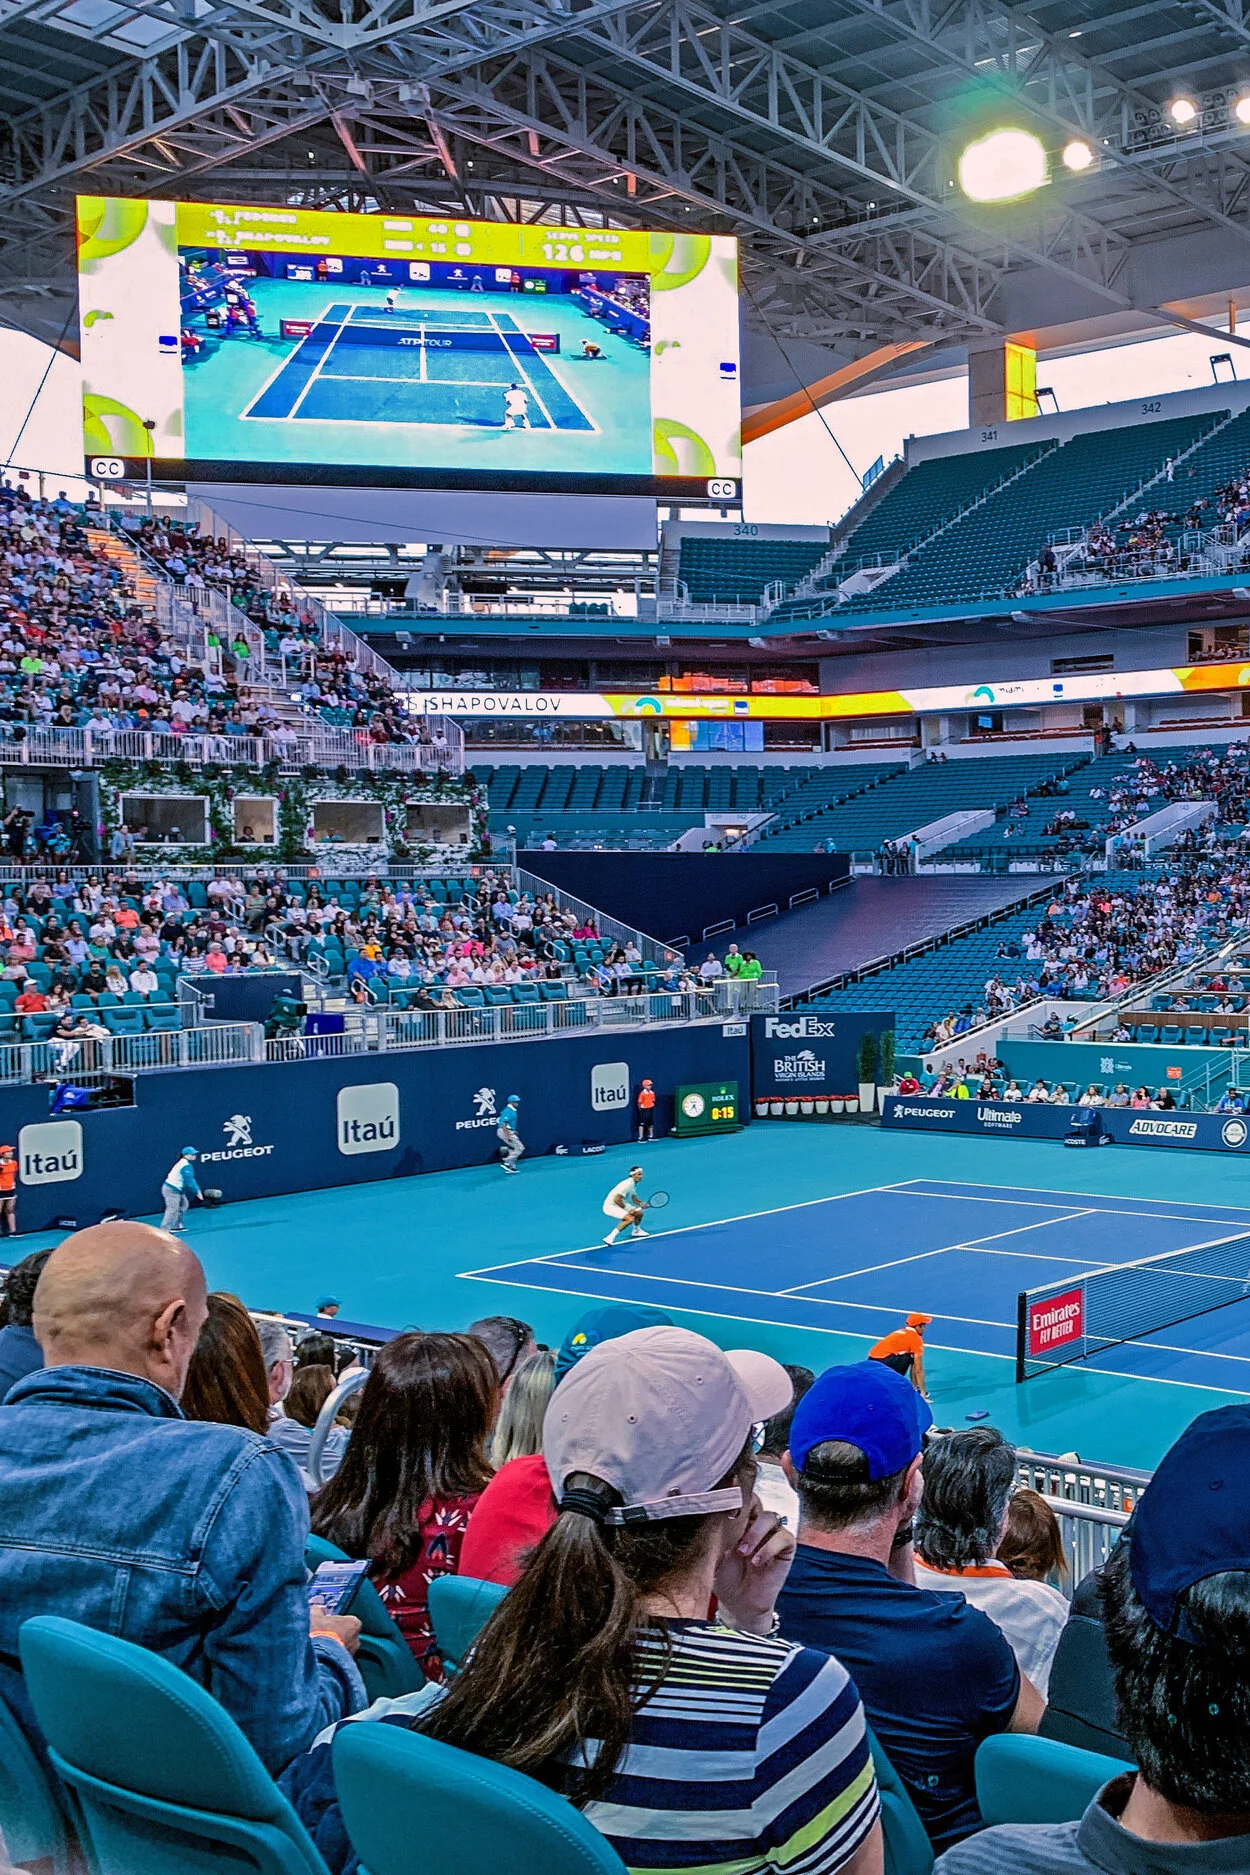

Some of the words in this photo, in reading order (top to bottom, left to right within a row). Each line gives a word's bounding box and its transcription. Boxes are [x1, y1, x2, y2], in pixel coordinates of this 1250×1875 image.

[541, 243, 585, 262] 126
[1141, 401, 1161, 415] 342
[981, 430, 998, 443] 341
[96, 461, 119, 475] CC
[711, 482, 732, 496] CC
[430, 697, 561, 711] SHAPOVALOV
[765, 1016, 835, 1038] FedEx
[774, 1059, 826, 1073] BRITISH
[595, 1084, 626, 1104] Itaú
[711, 1094, 735, 1102] ROLEX
[904, 1107, 956, 1119] PEUGEOT
[977, 1106, 1023, 1124] Ultimate
[343, 1115, 395, 1144] Itaú
[455, 1116, 501, 1131] PEUGE
[983, 1121, 1013, 1129] SOFTWARE
[1133, 1121, 1195, 1136] ADVOCARE
[201, 1145, 275, 1163] PEUGEOT
[24, 1150, 78, 1176] Itaú
[1032, 1302, 1081, 1331] Emirates
[1051, 1320, 1074, 1340] BETTER
